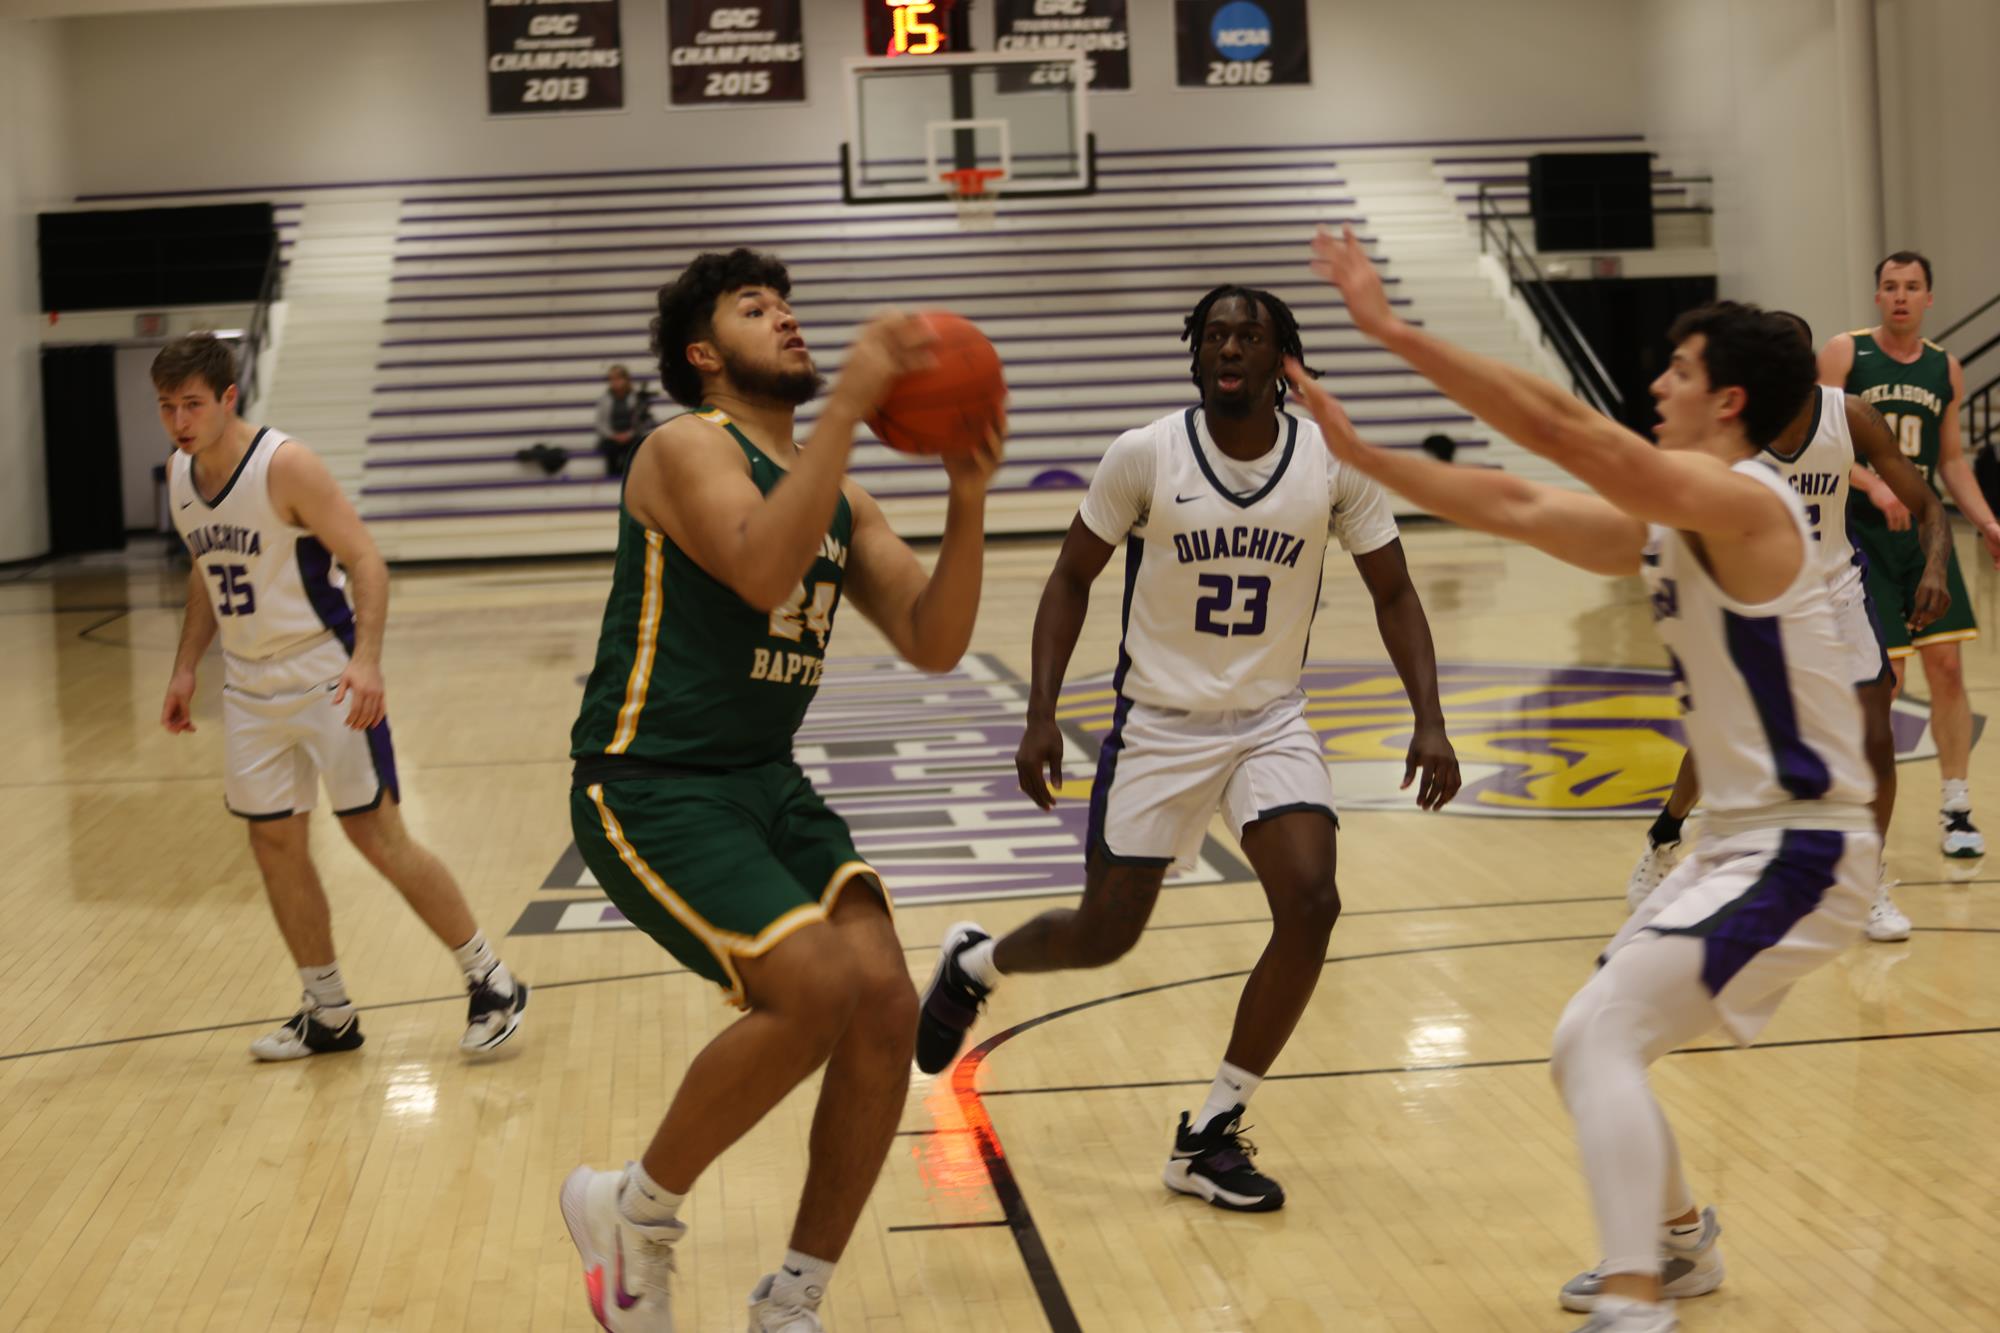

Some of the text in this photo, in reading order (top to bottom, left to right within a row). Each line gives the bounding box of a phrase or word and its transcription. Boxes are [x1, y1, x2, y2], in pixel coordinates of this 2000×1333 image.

[528, 13, 579, 35] GAC
[709, 7, 760, 29] GAC
[893, 3, 939, 54] 15
[997, 31, 1127, 51] CHAMPIONS
[1216, 28, 1271, 47] NCAA
[489, 49, 620, 72] CHAMPIONS
[671, 43, 801, 66] CHAMPIONS
[704, 71, 771, 97] 2015
[1205, 60, 1272, 85] 2016
[522, 76, 588, 103] 2013
[1173, 526, 1305, 568] OUACHITA
[208, 564, 256, 616] 35
[1195, 573, 1271, 638] 23
